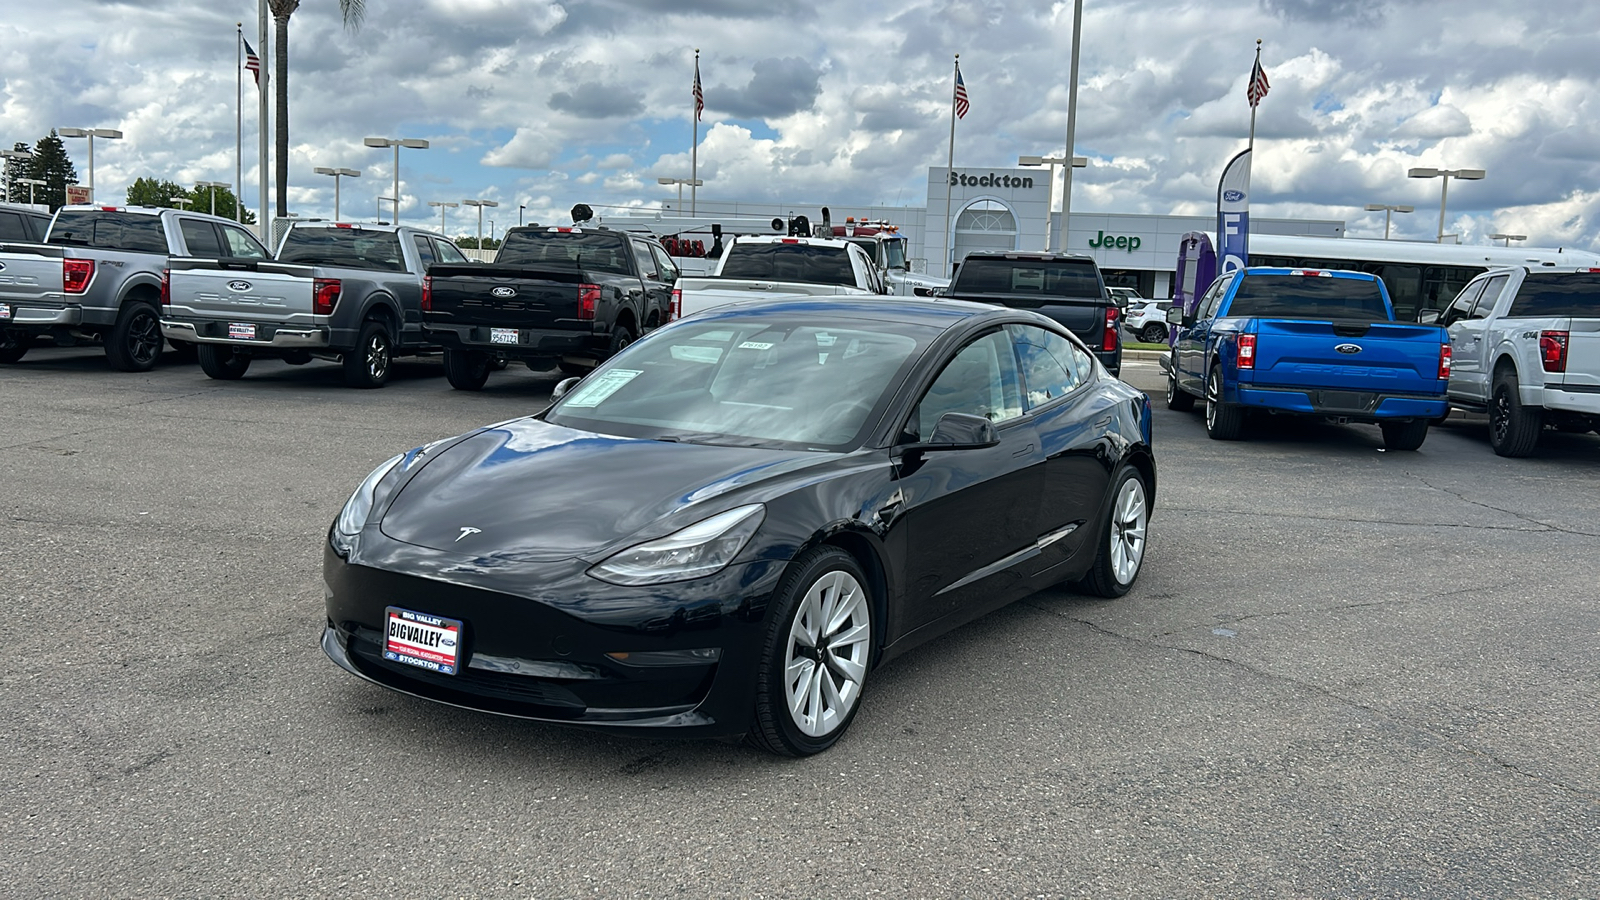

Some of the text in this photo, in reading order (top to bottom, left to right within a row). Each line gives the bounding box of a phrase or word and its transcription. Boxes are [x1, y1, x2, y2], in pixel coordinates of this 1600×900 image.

[947, 171, 1033, 188] Stockton
[1225, 191, 1242, 201] Ford
[1088, 230, 1141, 252] Jeep
[402, 612, 442, 625] BIG VALLEY
[390, 621, 442, 648] BIGVALLEY
[399, 655, 440, 669] STOCKTON
